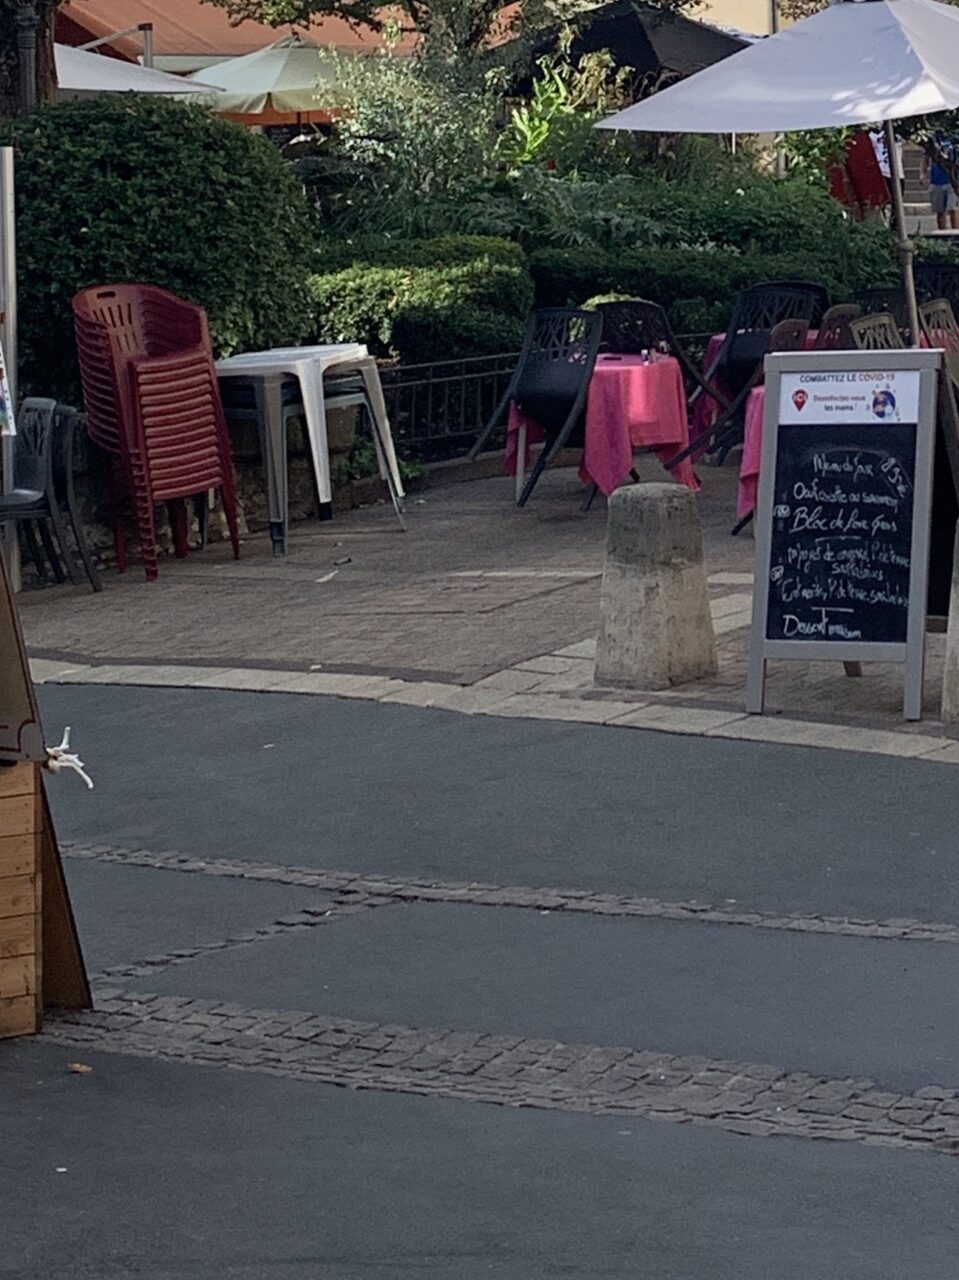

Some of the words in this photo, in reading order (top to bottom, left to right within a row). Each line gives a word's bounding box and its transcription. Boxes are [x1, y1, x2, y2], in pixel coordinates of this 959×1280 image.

[799, 374, 846, 383] COMBATTEZ
[846, 373, 857, 382] LE
[858, 373, 896, 382] COVID-19
